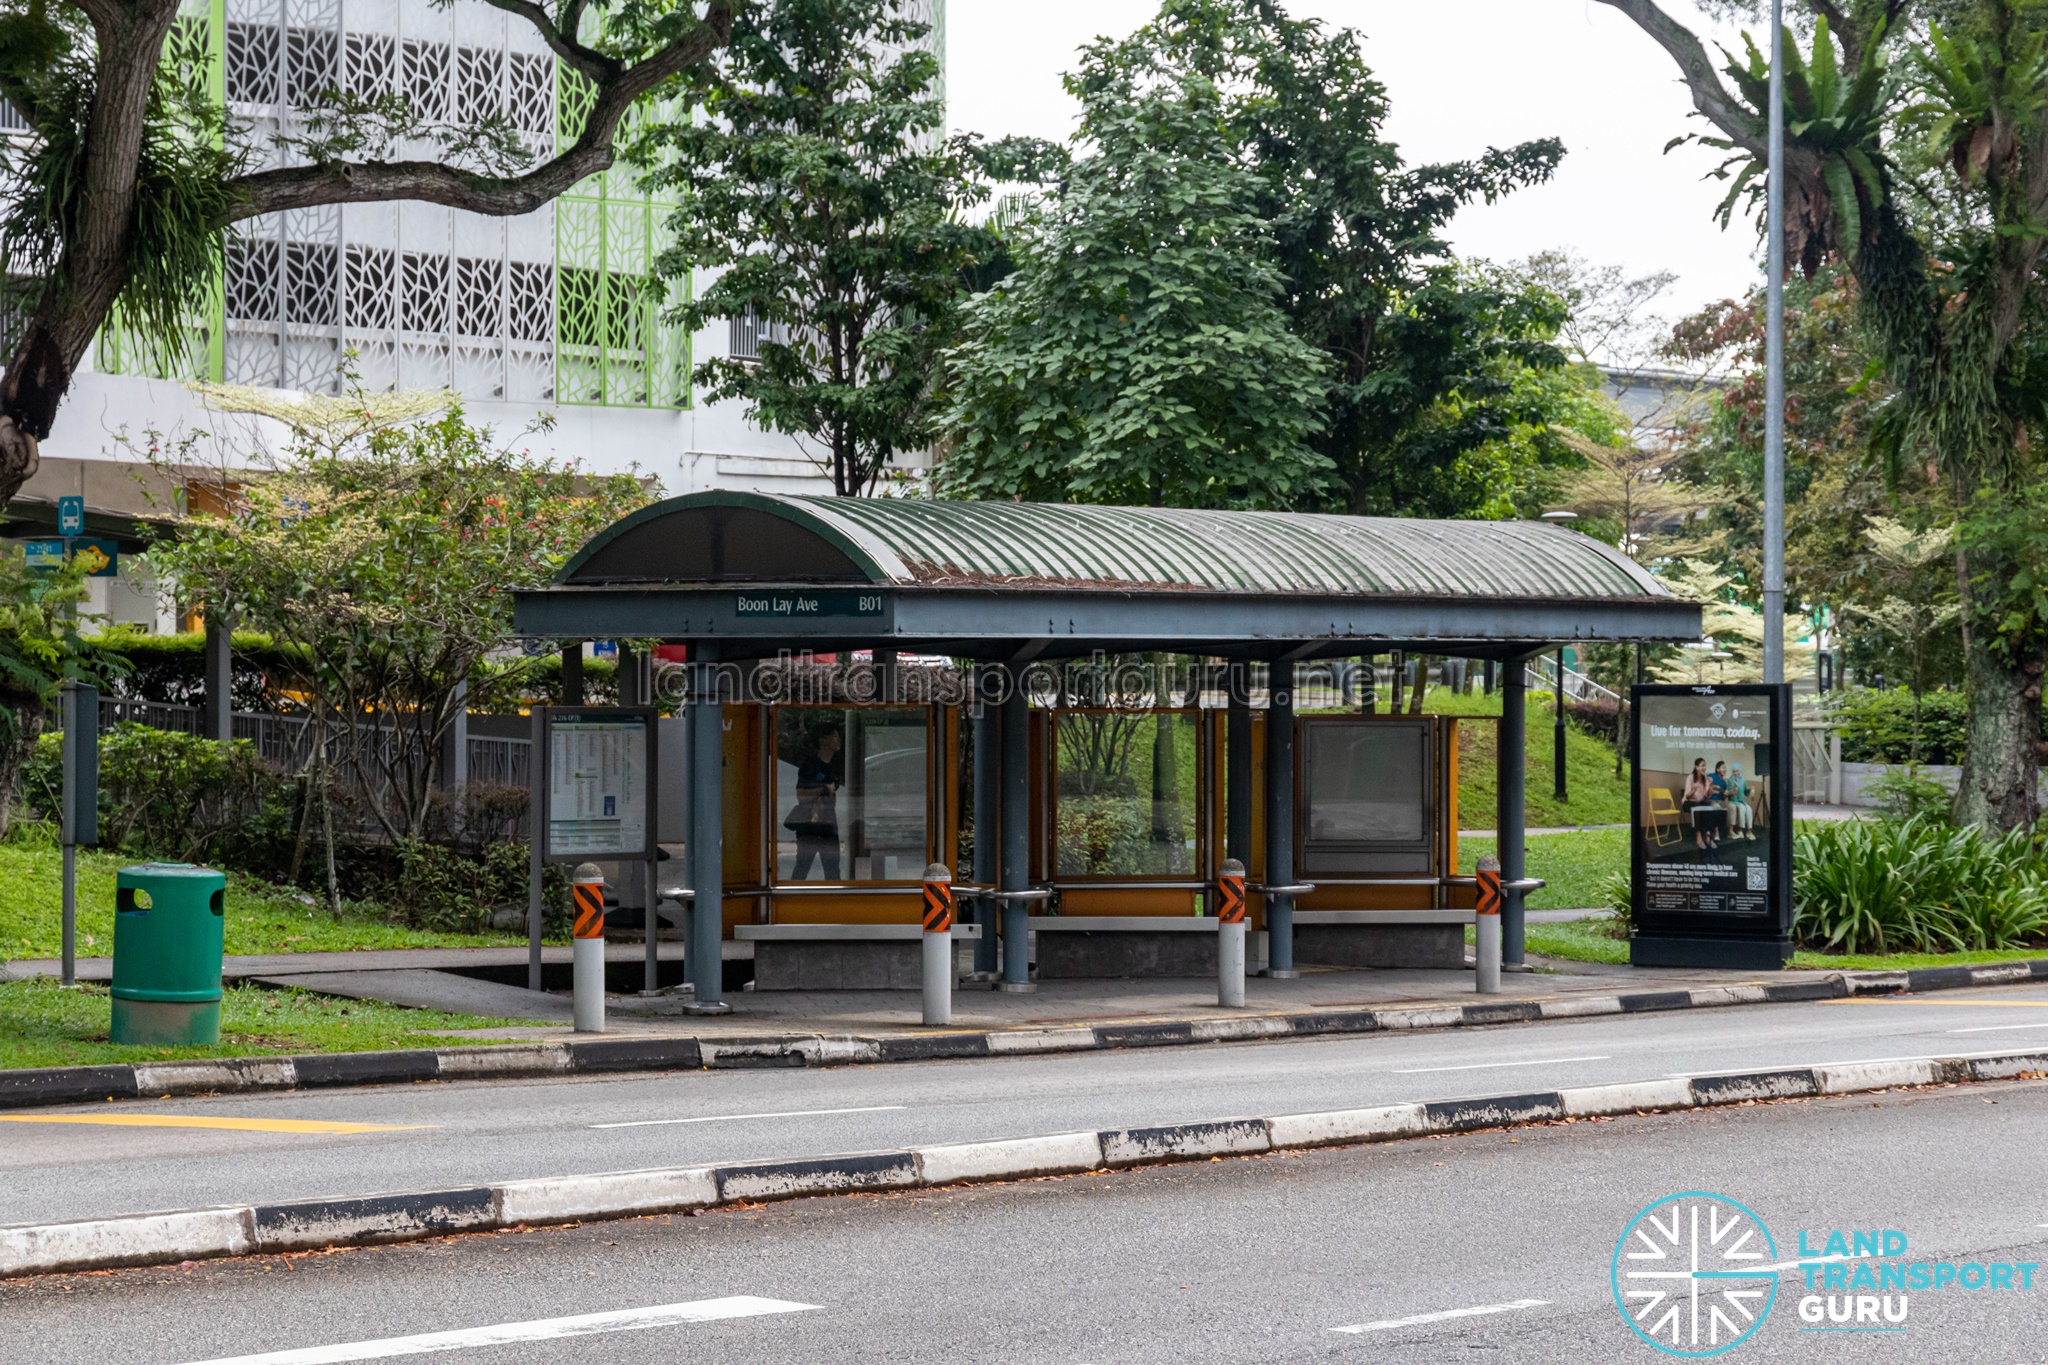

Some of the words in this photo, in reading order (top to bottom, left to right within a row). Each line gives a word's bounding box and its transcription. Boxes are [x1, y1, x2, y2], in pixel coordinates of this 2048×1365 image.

[738, 597, 769, 611] Boon
[773, 597, 792, 615] Lay
[796, 597, 818, 611] Ave
[859, 596, 882, 611] B01
[1651, 725, 1667, 737] Live
[1669, 725, 1681, 737] for
[1683, 726, 1726, 739] tomorrow,
[1726, 726, 1761, 740] today.
